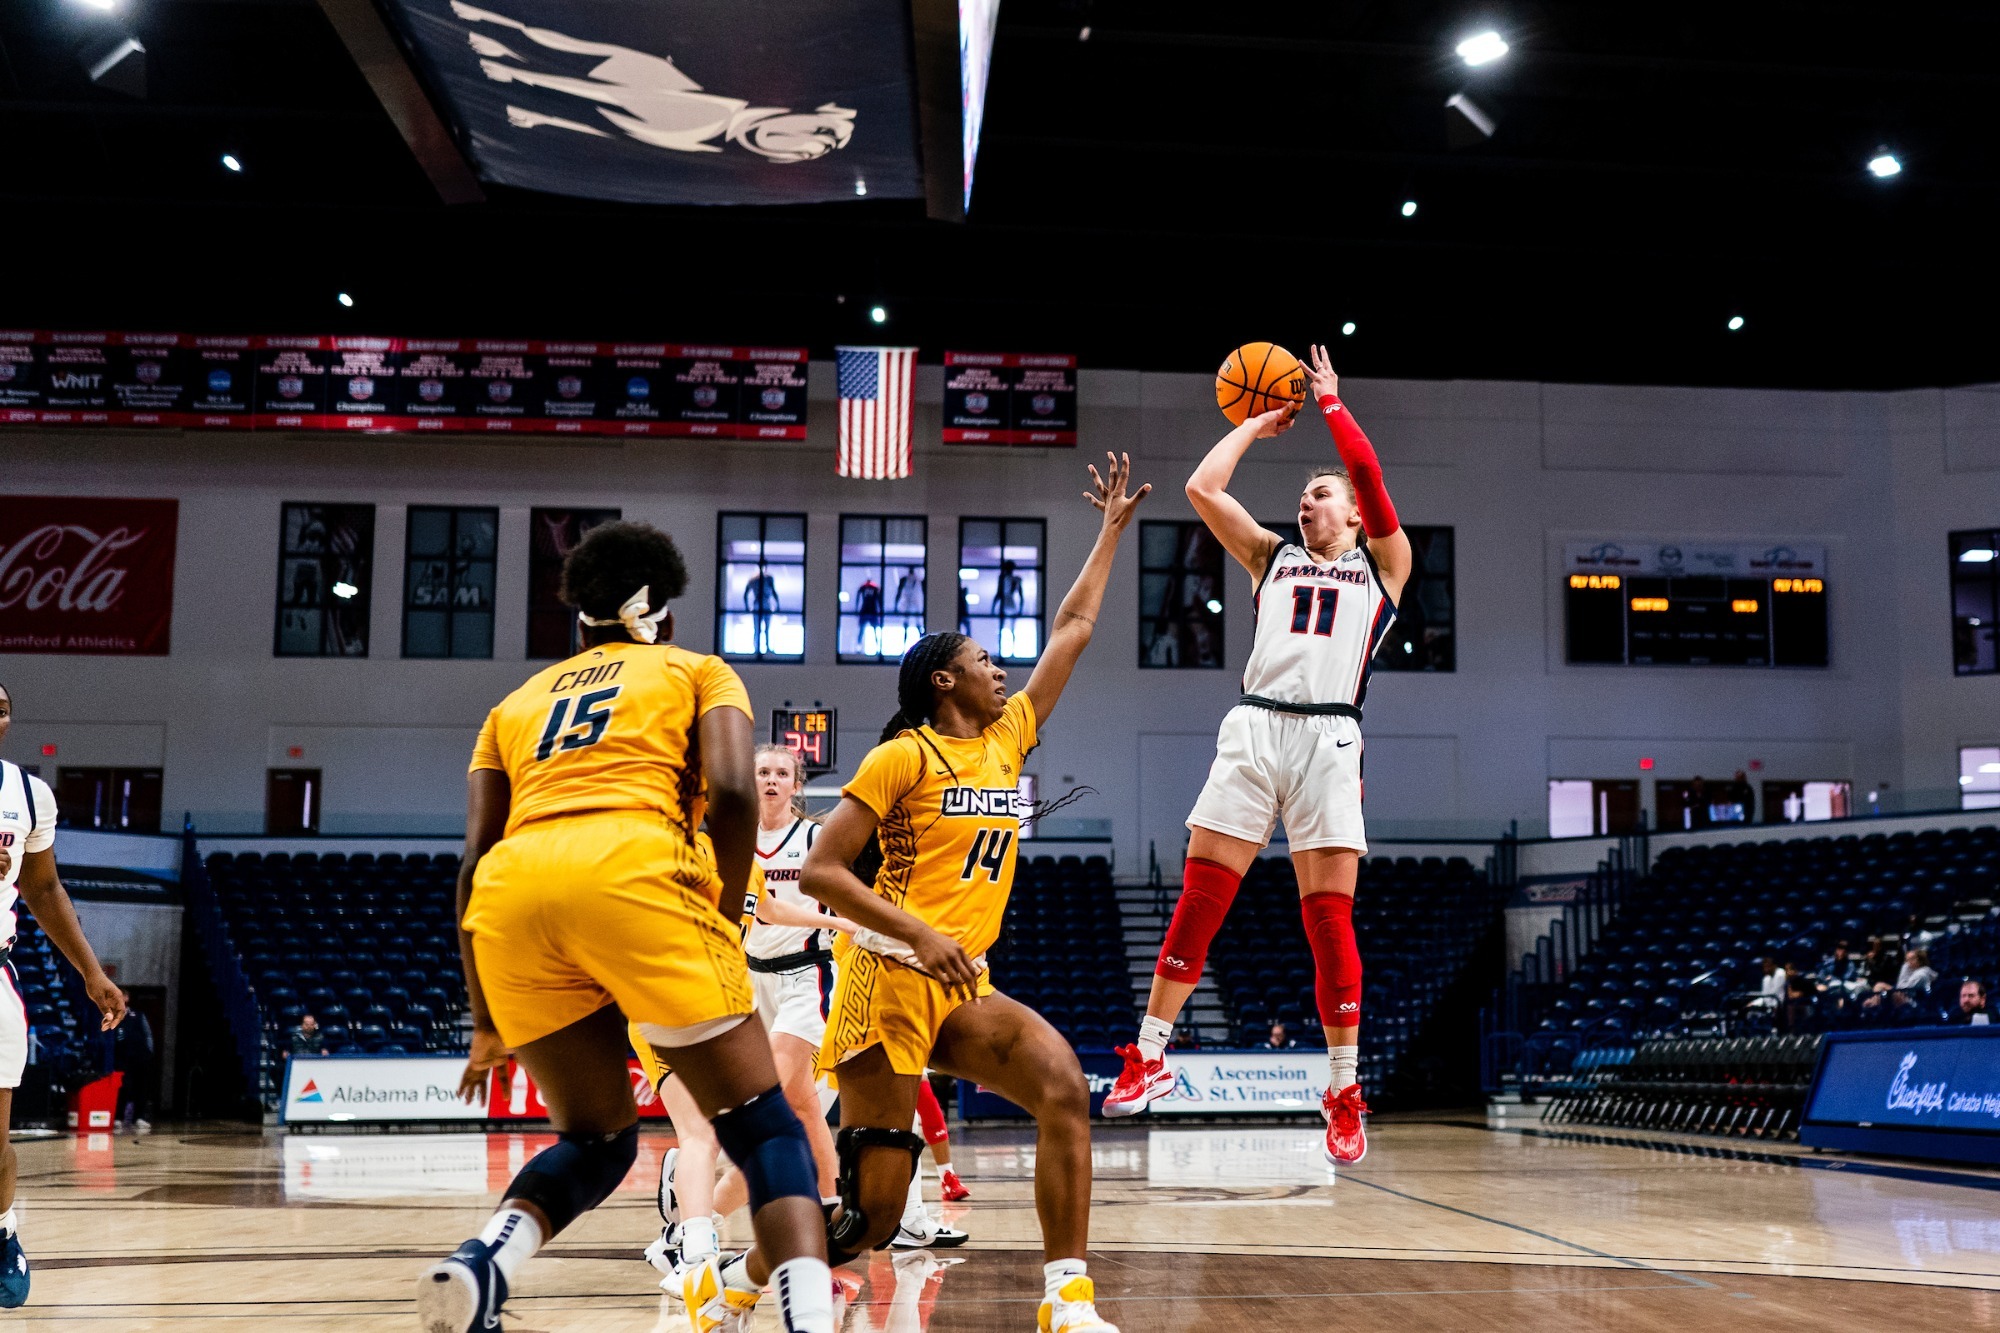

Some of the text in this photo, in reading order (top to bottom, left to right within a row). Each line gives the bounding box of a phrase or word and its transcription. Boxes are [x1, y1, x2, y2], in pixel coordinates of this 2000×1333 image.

[51, 371, 102, 389] WNIT
[0, 525, 149, 613] Cola
[1290, 585, 1340, 638] 11
[66, 635, 136, 649] Athletics
[550, 660, 625, 694] CAIN
[534, 684, 624, 762] 15
[940, 785, 1020, 819] UNCG
[960, 828, 1014, 883] 14
[764, 868, 801, 882] FORD
[1210, 1065, 1308, 1081] Ascension
[330, 1084, 482, 1104] Alabama Pow
[1209, 1086, 1324, 1102] St. Vincent's
